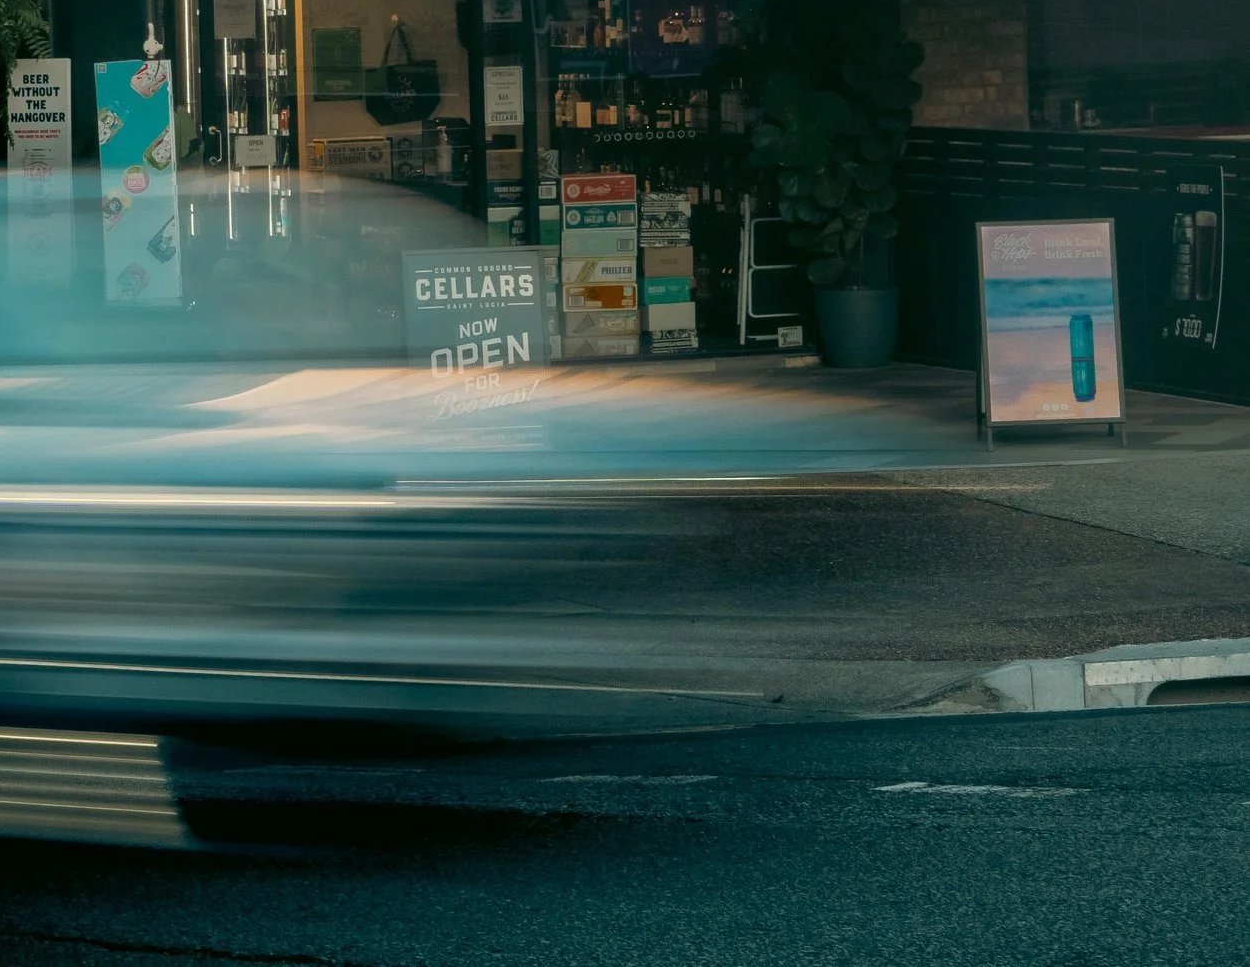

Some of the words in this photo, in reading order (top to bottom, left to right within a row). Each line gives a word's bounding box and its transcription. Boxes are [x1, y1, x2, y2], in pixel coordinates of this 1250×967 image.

[22, 74, 49, 84] BEER
[13, 86, 60, 97] WITHOUT
[25, 99, 47, 110] THE
[10, 112, 66, 122] HANGOVER
[1044, 250, 1073, 259] Drink
[434, 266, 471, 274] COMMON
[477, 264, 513, 272] GROUND
[601, 266, 633, 274] PHILTER
[415, 274, 534, 301] CELLARS
[479, 301, 506, 309] LUCIA
[459, 317, 498, 339] NOW
[430, 332, 531, 379] OPEN
[465, 372, 500, 393] FOR
